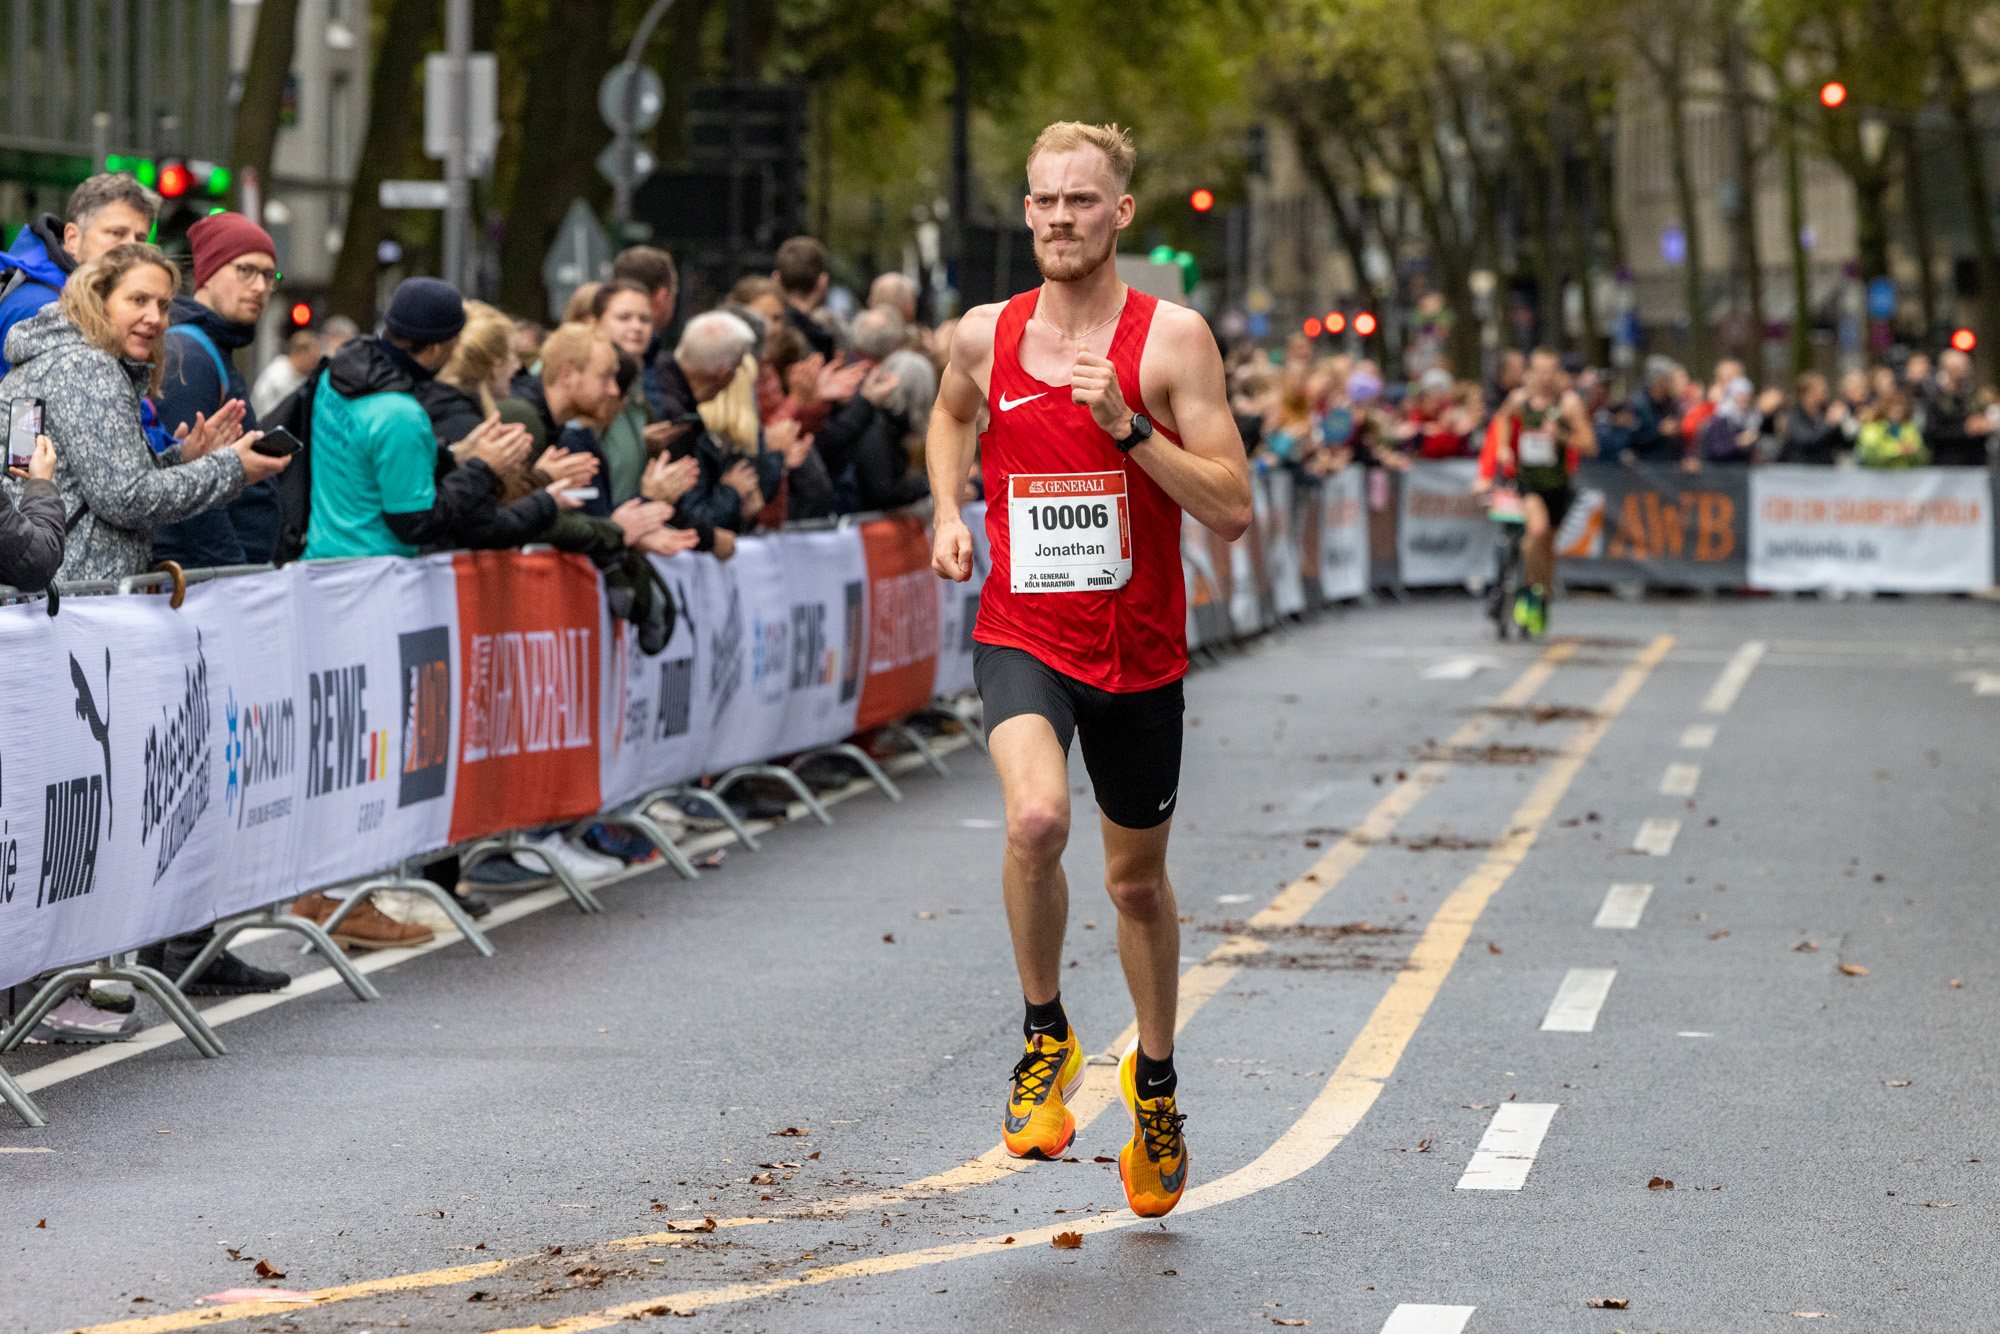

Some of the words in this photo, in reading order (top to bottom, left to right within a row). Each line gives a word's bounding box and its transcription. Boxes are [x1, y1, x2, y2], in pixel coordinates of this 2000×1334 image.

[1045, 479, 1105, 493] GENERALI
[1028, 503, 1109, 531] 10006
[1609, 491, 1736, 562] AWB
[1034, 543, 1105, 557] Jonathan
[1024, 580, 1040, 588] KÖLN
[1041, 580, 1075, 588] MARATHON
[1039, 572, 1069, 580] GENERALI
[1087, 576, 1113, 586] PUMA
[306, 664, 367, 800] REWE
[237, 697, 296, 831] pixum
[37, 774, 102, 908] PUMA
[0, 820, 17, 904] ie
